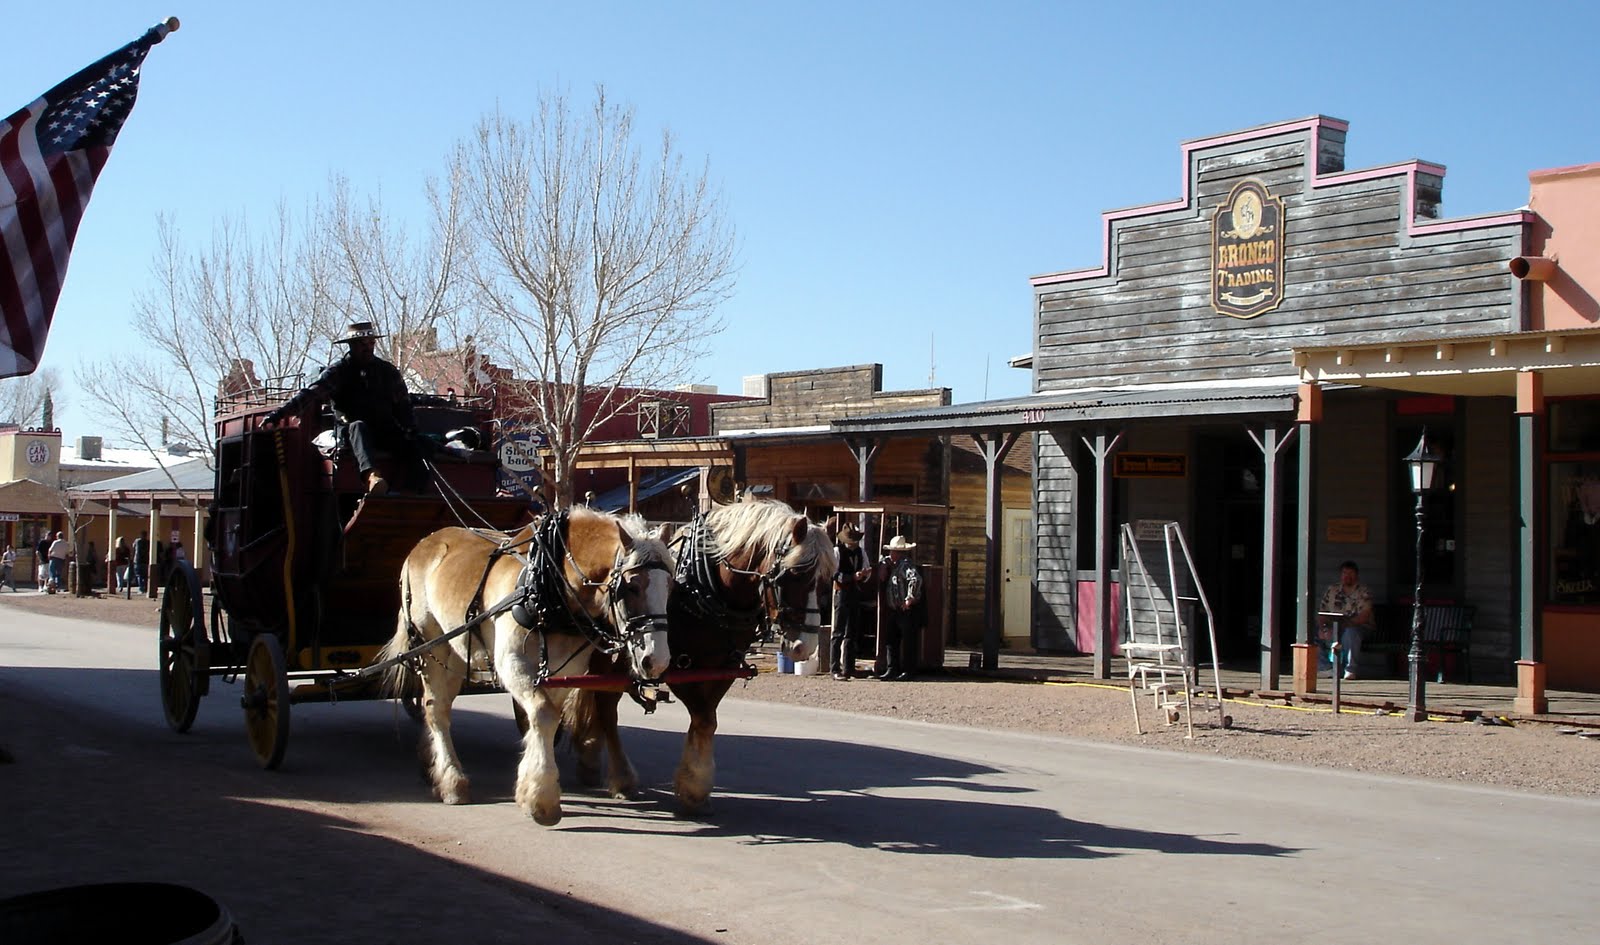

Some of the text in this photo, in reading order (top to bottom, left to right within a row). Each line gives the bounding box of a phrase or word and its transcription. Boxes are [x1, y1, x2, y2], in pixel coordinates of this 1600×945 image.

[1218, 240, 1275, 269] BRONCO
[1022, 409, 1045, 424] 410
[29, 454, 46, 463] CAN
[507, 455, 535, 466] Lad
